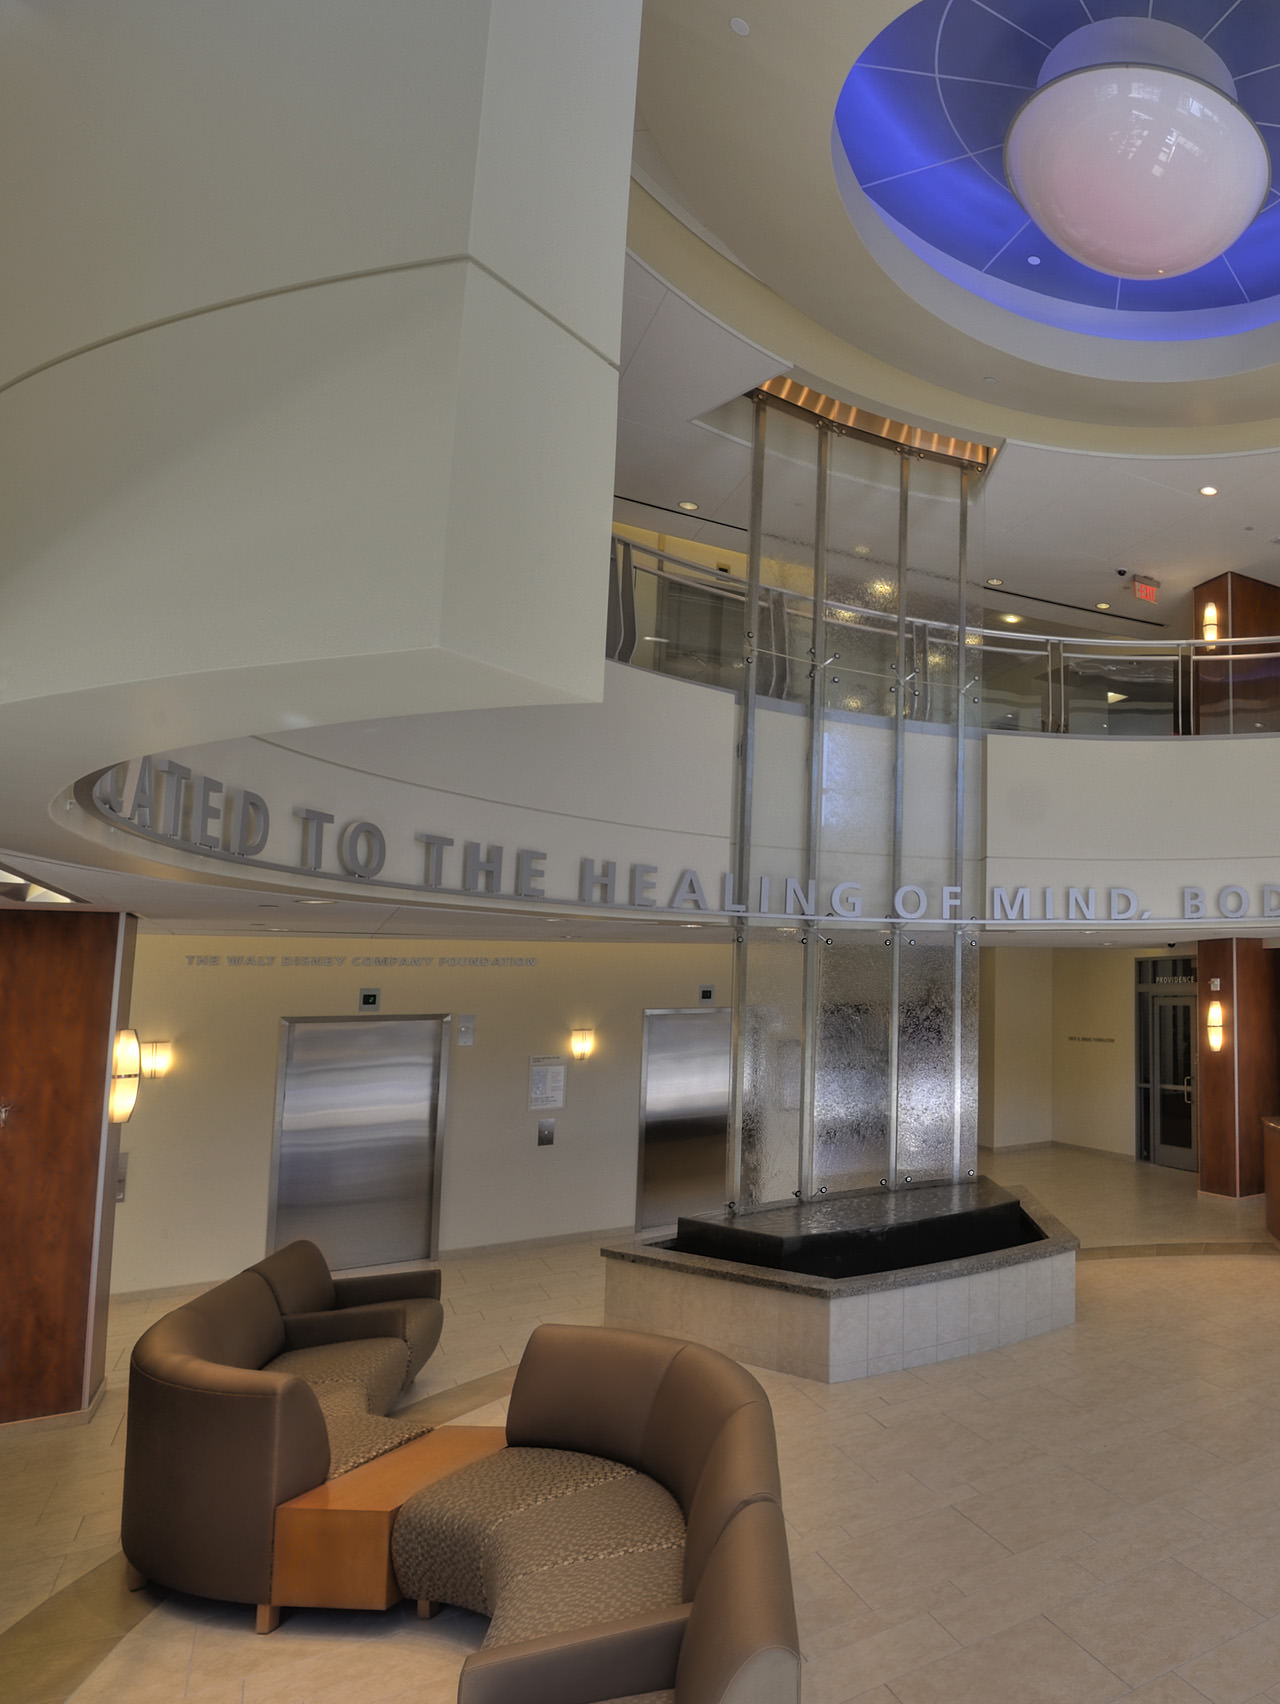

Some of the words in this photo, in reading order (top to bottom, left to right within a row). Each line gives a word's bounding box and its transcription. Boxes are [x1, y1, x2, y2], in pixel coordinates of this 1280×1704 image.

[294, 808, 387, 880] TO
[417, 833, 548, 898] THE
[579, 857, 863, 918] HEALING
[894, 885, 961, 919] OF
[992, 887, 1151, 920] MIND,
[186, 955, 220, 966] THE
[227, 956, 275, 966] WALT
[281, 956, 347, 967] DISNEY
[351, 956, 433, 968] COMPANY
[439, 956, 537, 968] FOUNDATION
[1156, 976, 1194, 985] PROVIDENCE
